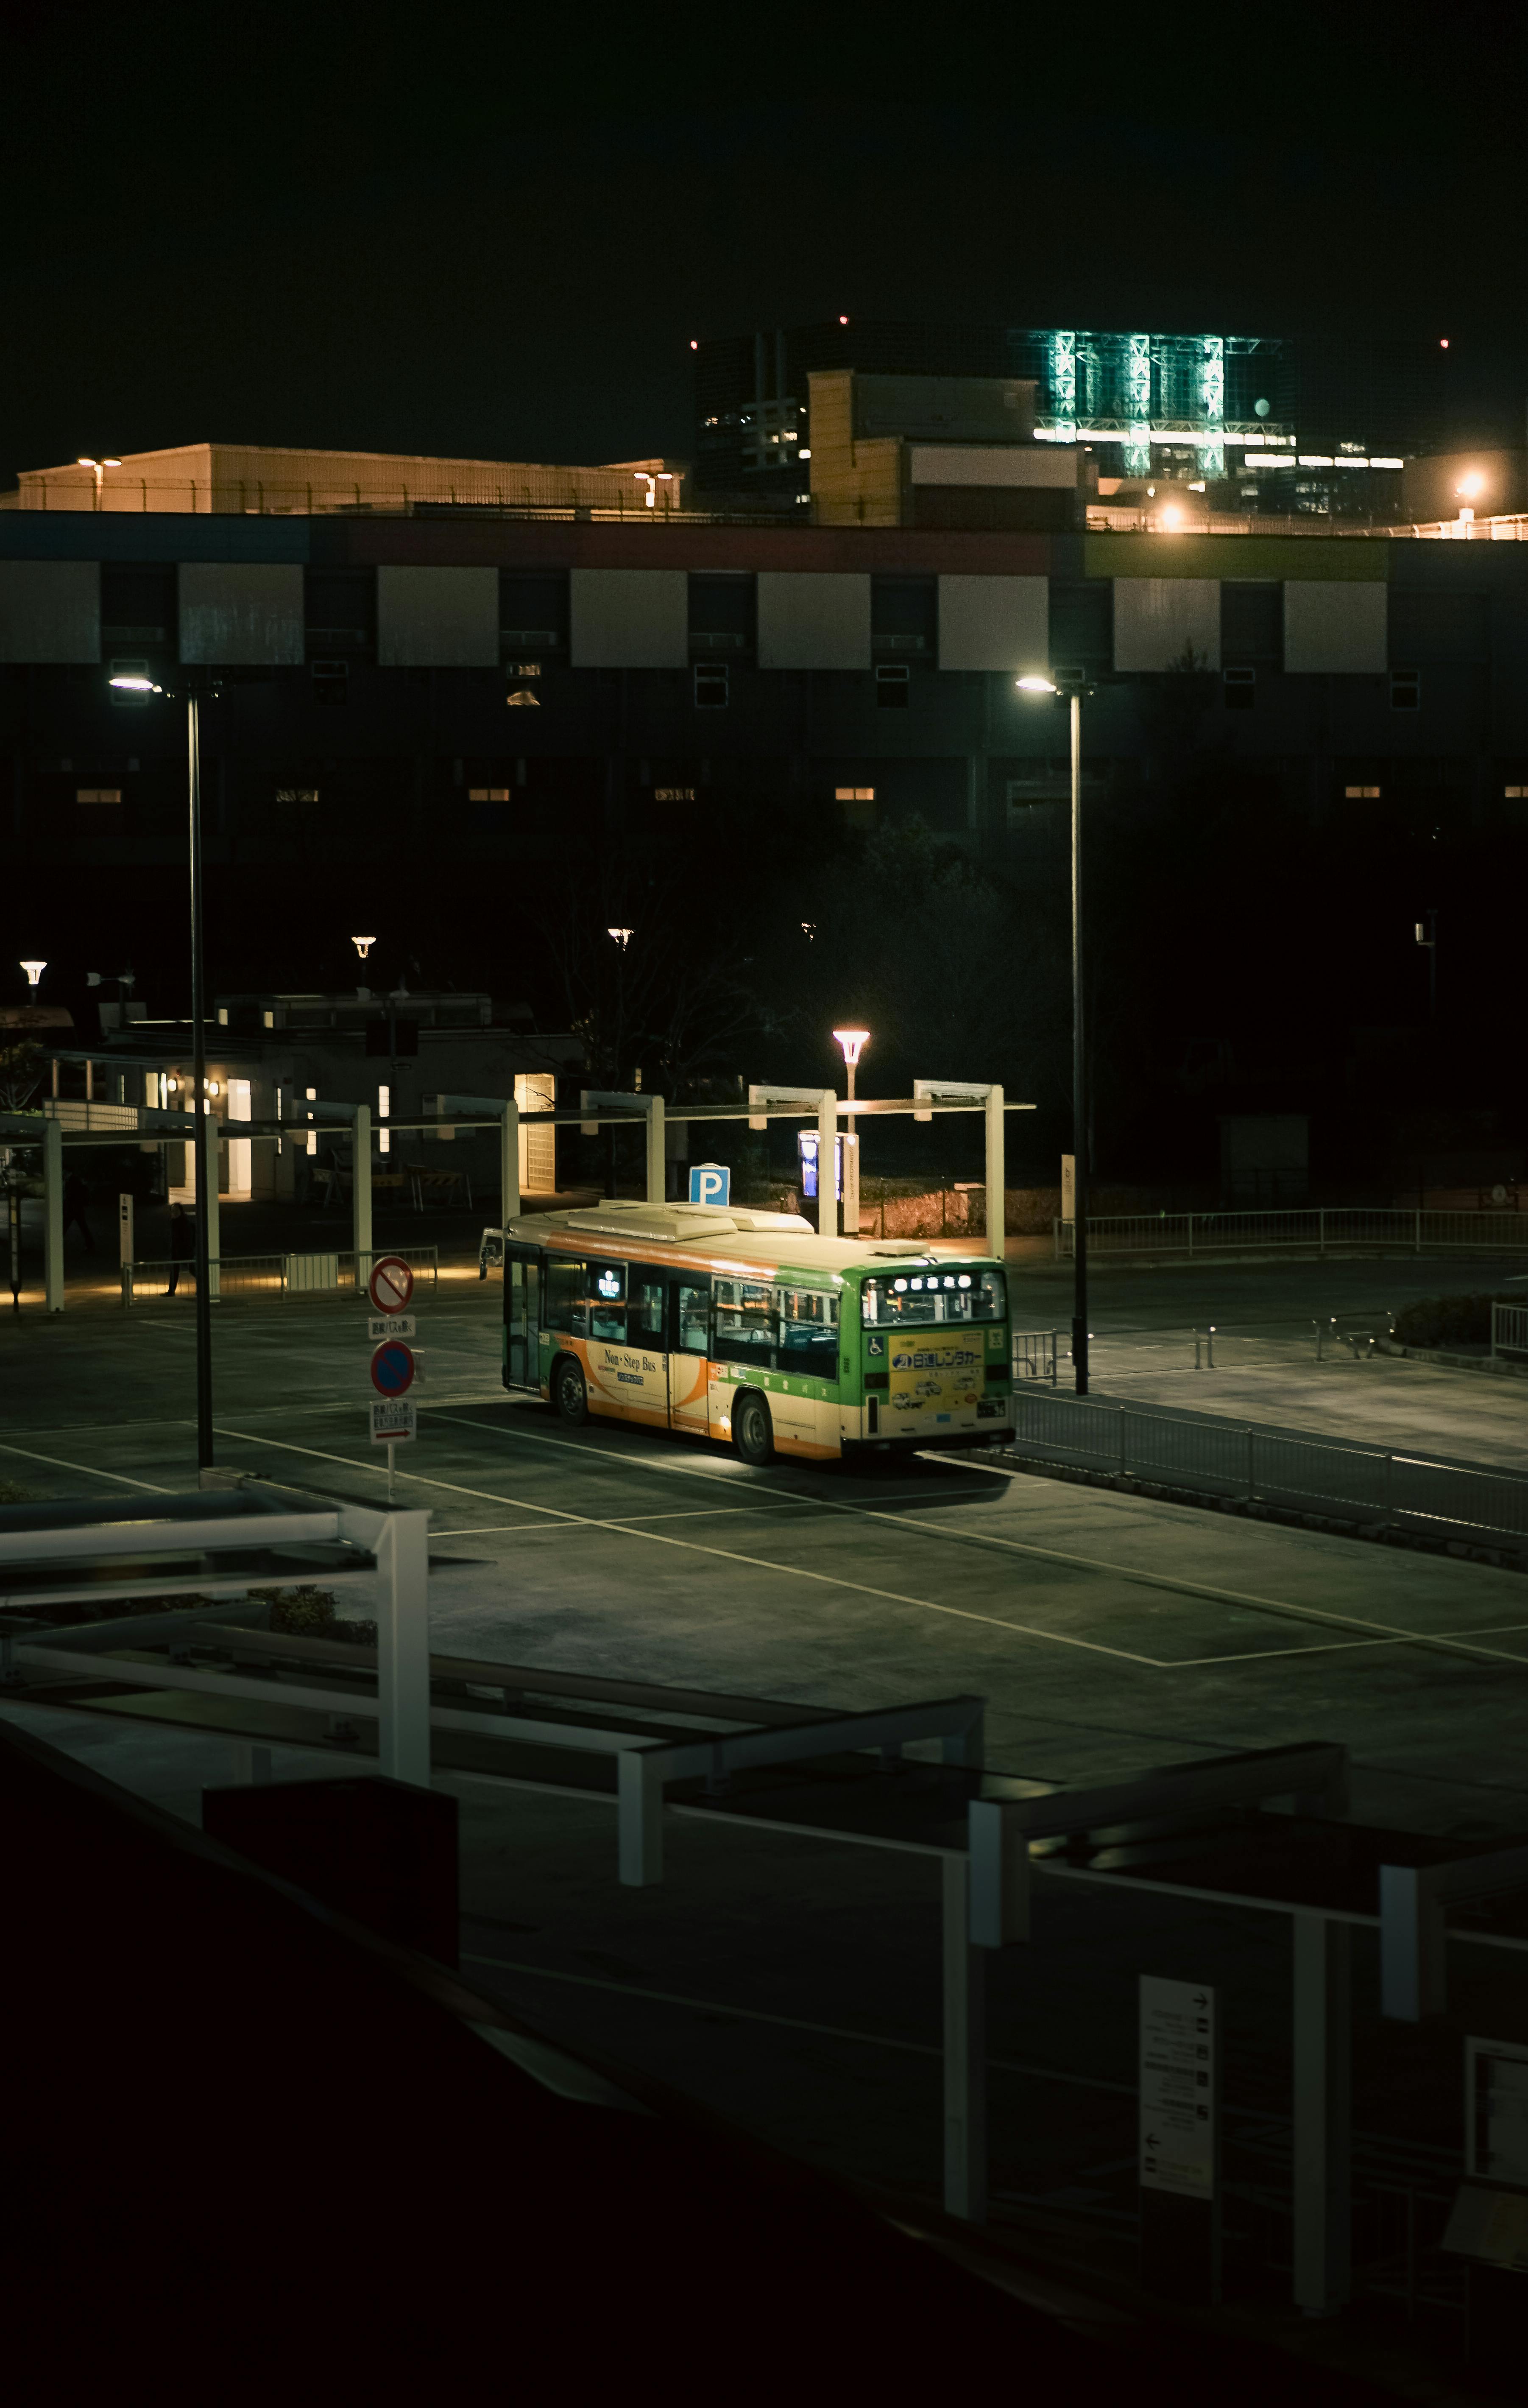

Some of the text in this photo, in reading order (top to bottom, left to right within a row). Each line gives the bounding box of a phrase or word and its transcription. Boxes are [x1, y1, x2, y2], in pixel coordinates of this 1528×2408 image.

[700, 1172, 722, 1204] P
[642, 1356, 656, 1372] Bus
[913, 1351, 981, 1369] 日進レンタカー
